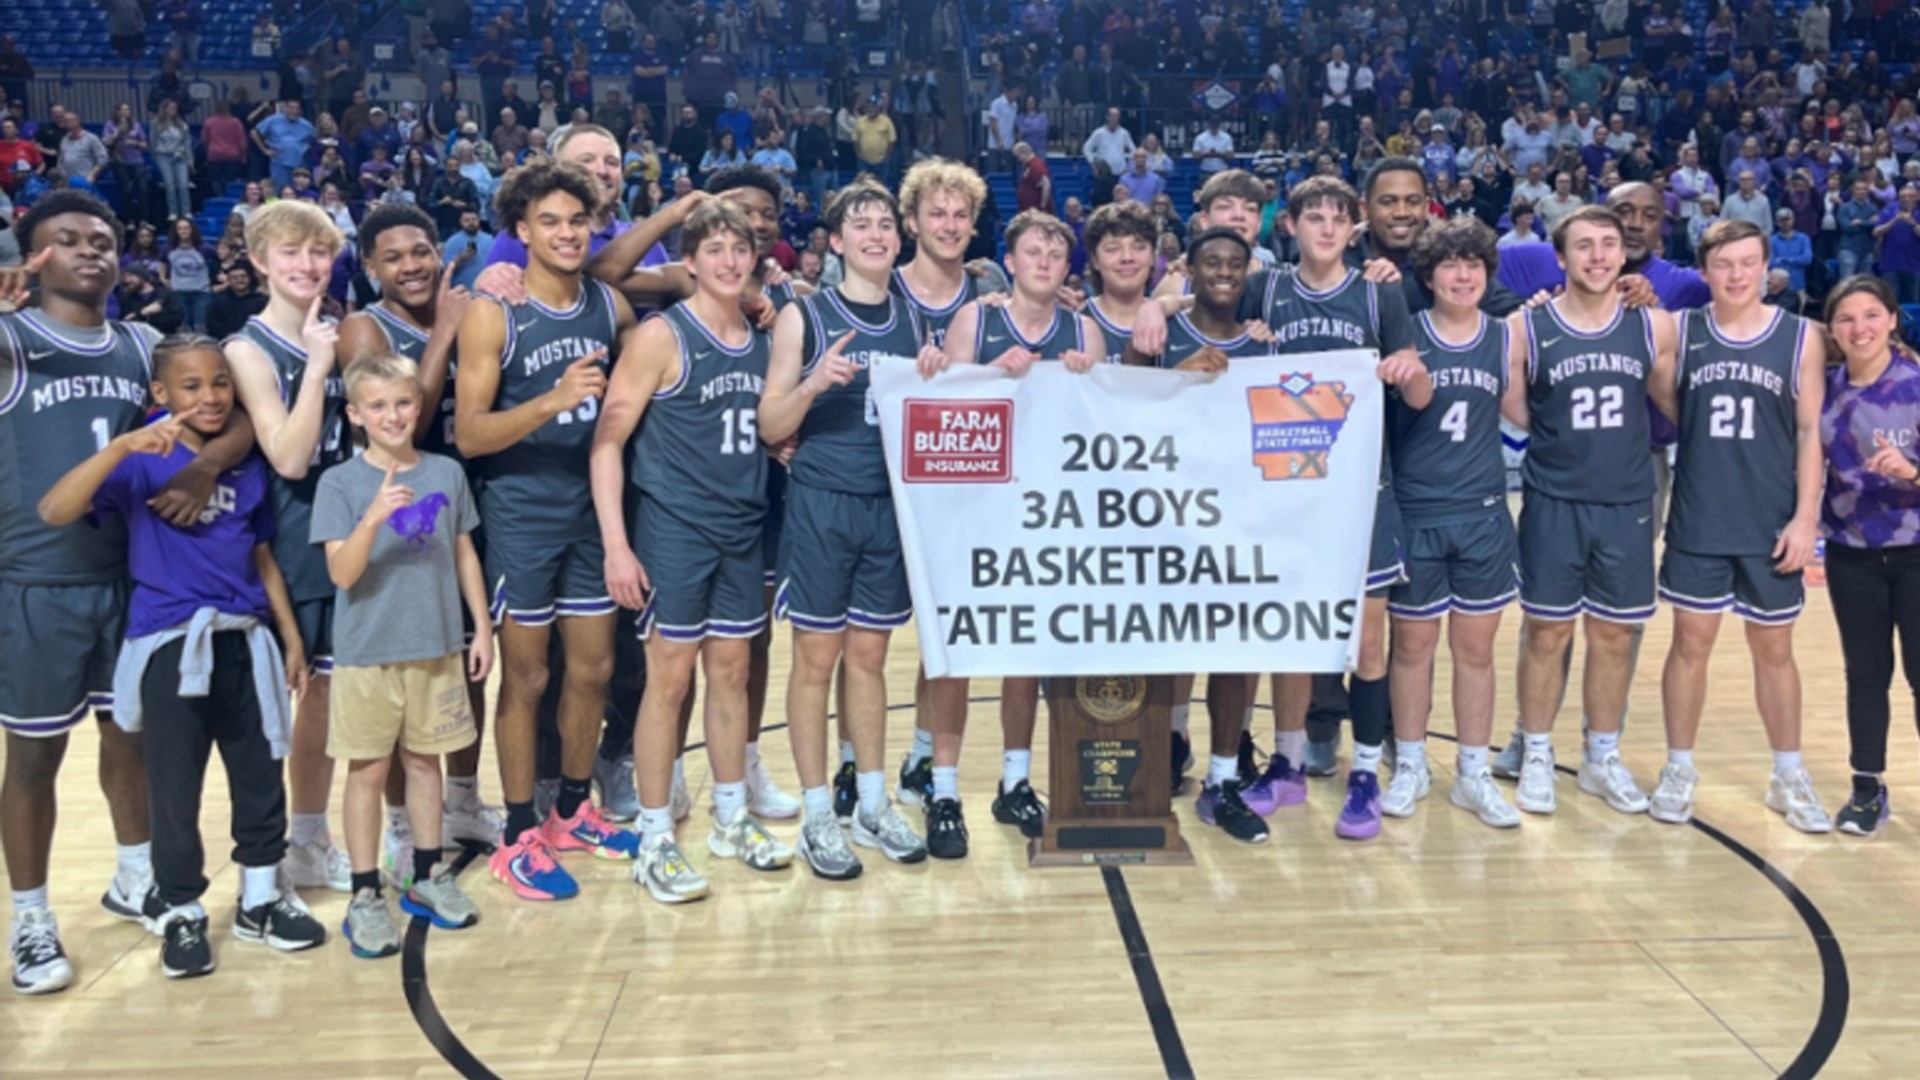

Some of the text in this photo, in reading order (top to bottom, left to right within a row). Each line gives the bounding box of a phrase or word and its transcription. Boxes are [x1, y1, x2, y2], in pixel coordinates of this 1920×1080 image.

[1548, 353, 1643, 386] MUSTANGS
[1689, 361, 1783, 397] MUSTANGS
[941, 410, 1000, 430] FARM
[1439, 400, 1469, 442] 4
[1571, 384, 1624, 430] 22
[1709, 394, 1755, 440] 21
[720, 408, 757, 455] 15
[914, 431, 1002, 453] BUREAU
[924, 459, 1001, 473] INSURANCE
[1061, 434, 1180, 472] 2024
[1022, 488, 1223, 530] 3A BOYS
[970, 544, 1279, 589] BASKETBALL
[1048, 598, 1357, 645] CHAMPIONS
